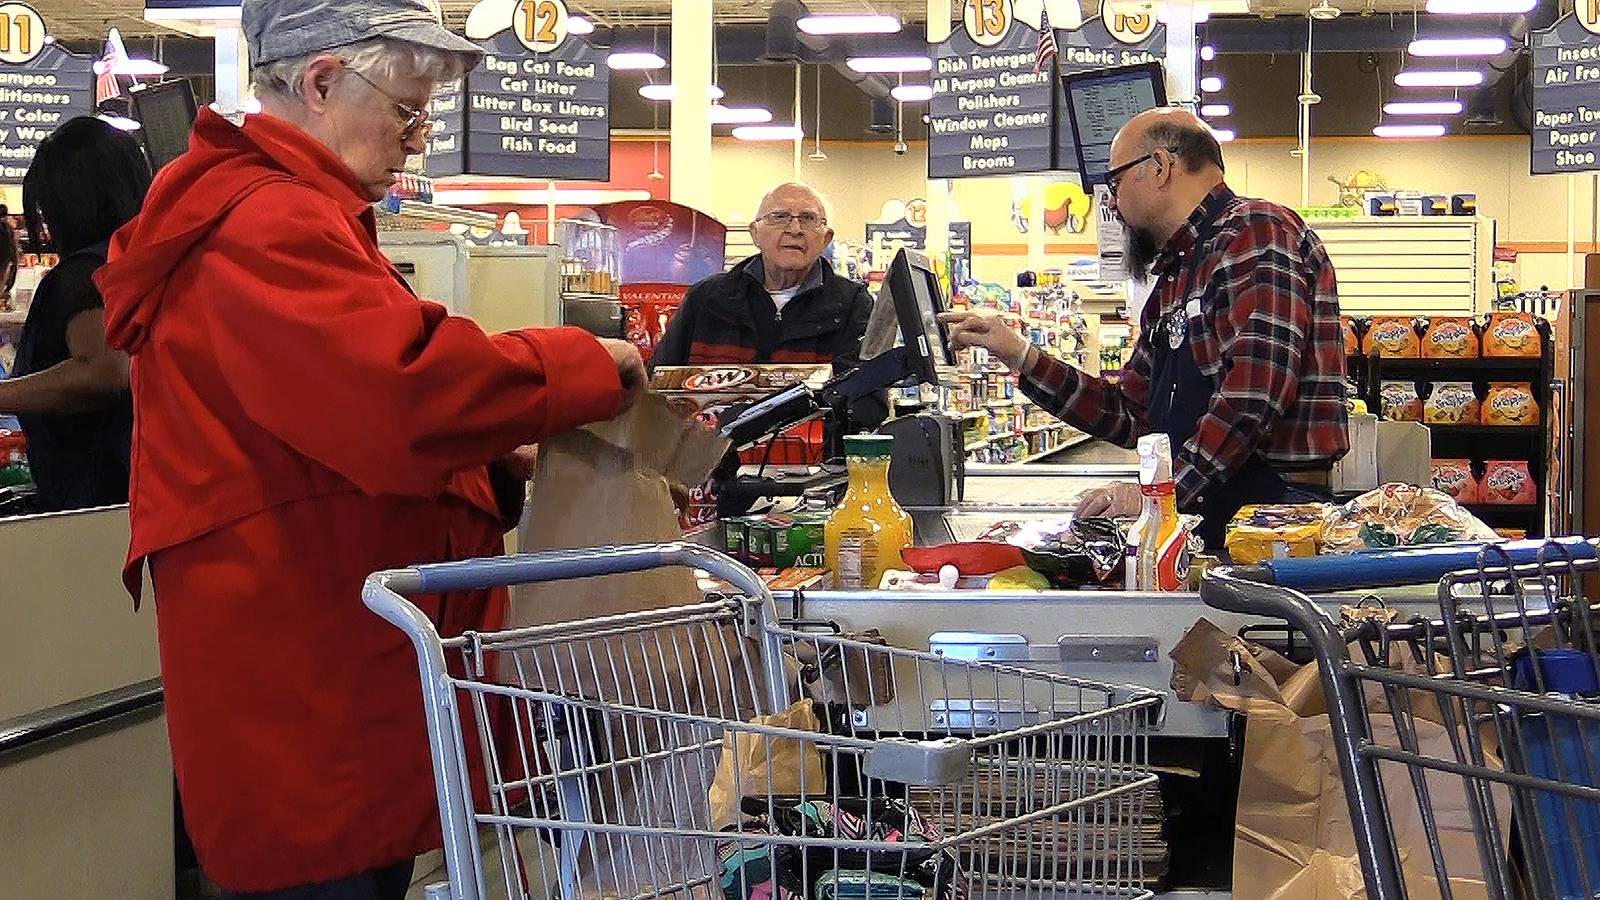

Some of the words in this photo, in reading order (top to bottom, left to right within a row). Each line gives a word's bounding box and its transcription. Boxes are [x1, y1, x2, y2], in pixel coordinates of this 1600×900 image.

[521, 0, 558, 43] 12
[971, 0, 1006, 36] 13
[938, 57, 968, 73] Dish
[972, 51, 1036, 73] Detergen
[1067, 47, 1115, 65] Fabric
[486, 56, 518, 74] Bag
[523, 59, 551, 74] Cat
[556, 61, 595, 78] Food
[1545, 67, 1570, 84] Air
[500, 77, 529, 92] Cat
[535, 79, 577, 96] Litter
[933, 79, 948, 92] All
[951, 76, 996, 93] Purpose
[999, 71, 1049, 87] Cleaners
[472, 95, 516, 111] Litter
[521, 98, 553, 114] Box
[558, 101, 607, 118] Liners
[958, 94, 1020, 111] Polishers
[14, 108, 61, 123] Color
[932, 116, 989, 133] Window
[993, 112, 1048, 128] Cleaner
[1535, 109, 1574, 127] Paper
[500, 116, 533, 132] Bird
[539, 119, 579, 134] Seed
[502, 136, 533, 151] Fish
[538, 138, 577, 154] Food
[970, 135, 1009, 152] Mops
[1550, 130, 1597, 147] Paper
[963, 154, 1015, 170] Brooms
[1555, 150, 1595, 166] Shoe
[622, 292, 683, 300] VALENTIN
[793, 553, 825, 568] ACTI
